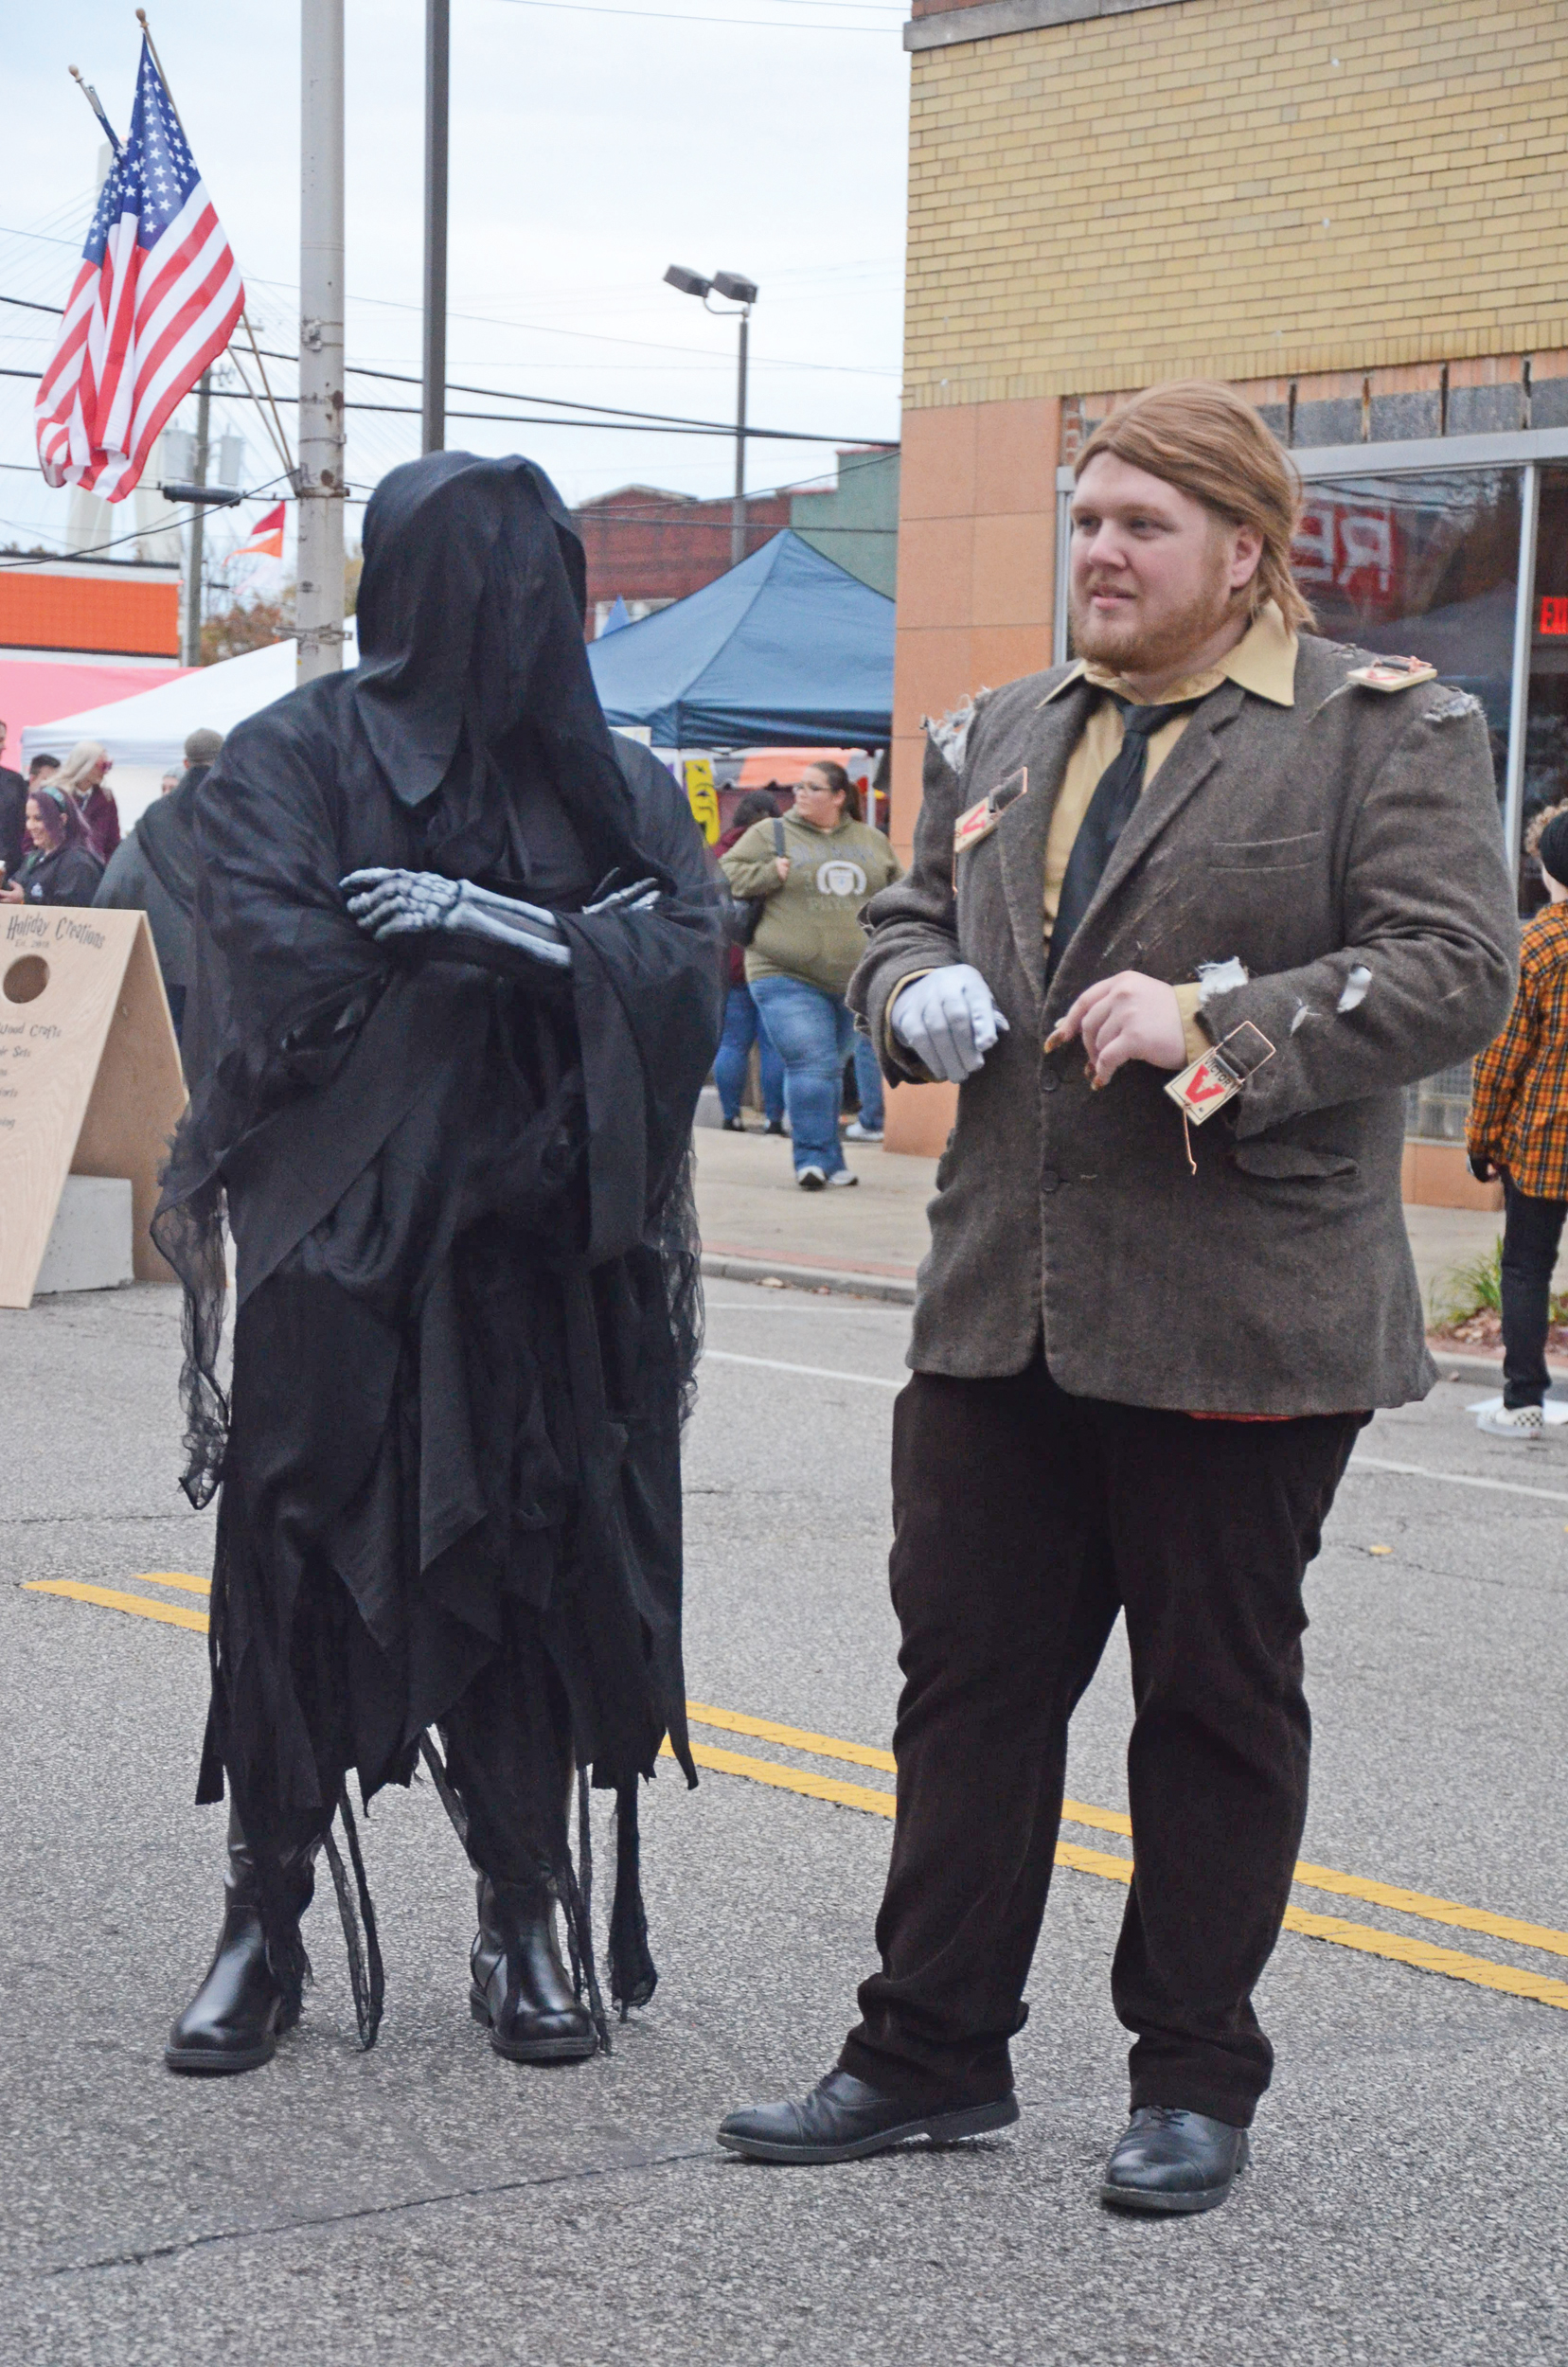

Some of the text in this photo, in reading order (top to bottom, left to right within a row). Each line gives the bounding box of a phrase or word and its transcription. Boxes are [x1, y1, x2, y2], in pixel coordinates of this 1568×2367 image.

[7, 912, 106, 950] Holiday Creations
[1185, 1062, 1226, 1105] V
[1204, 1055, 1231, 1088] VICTOR
